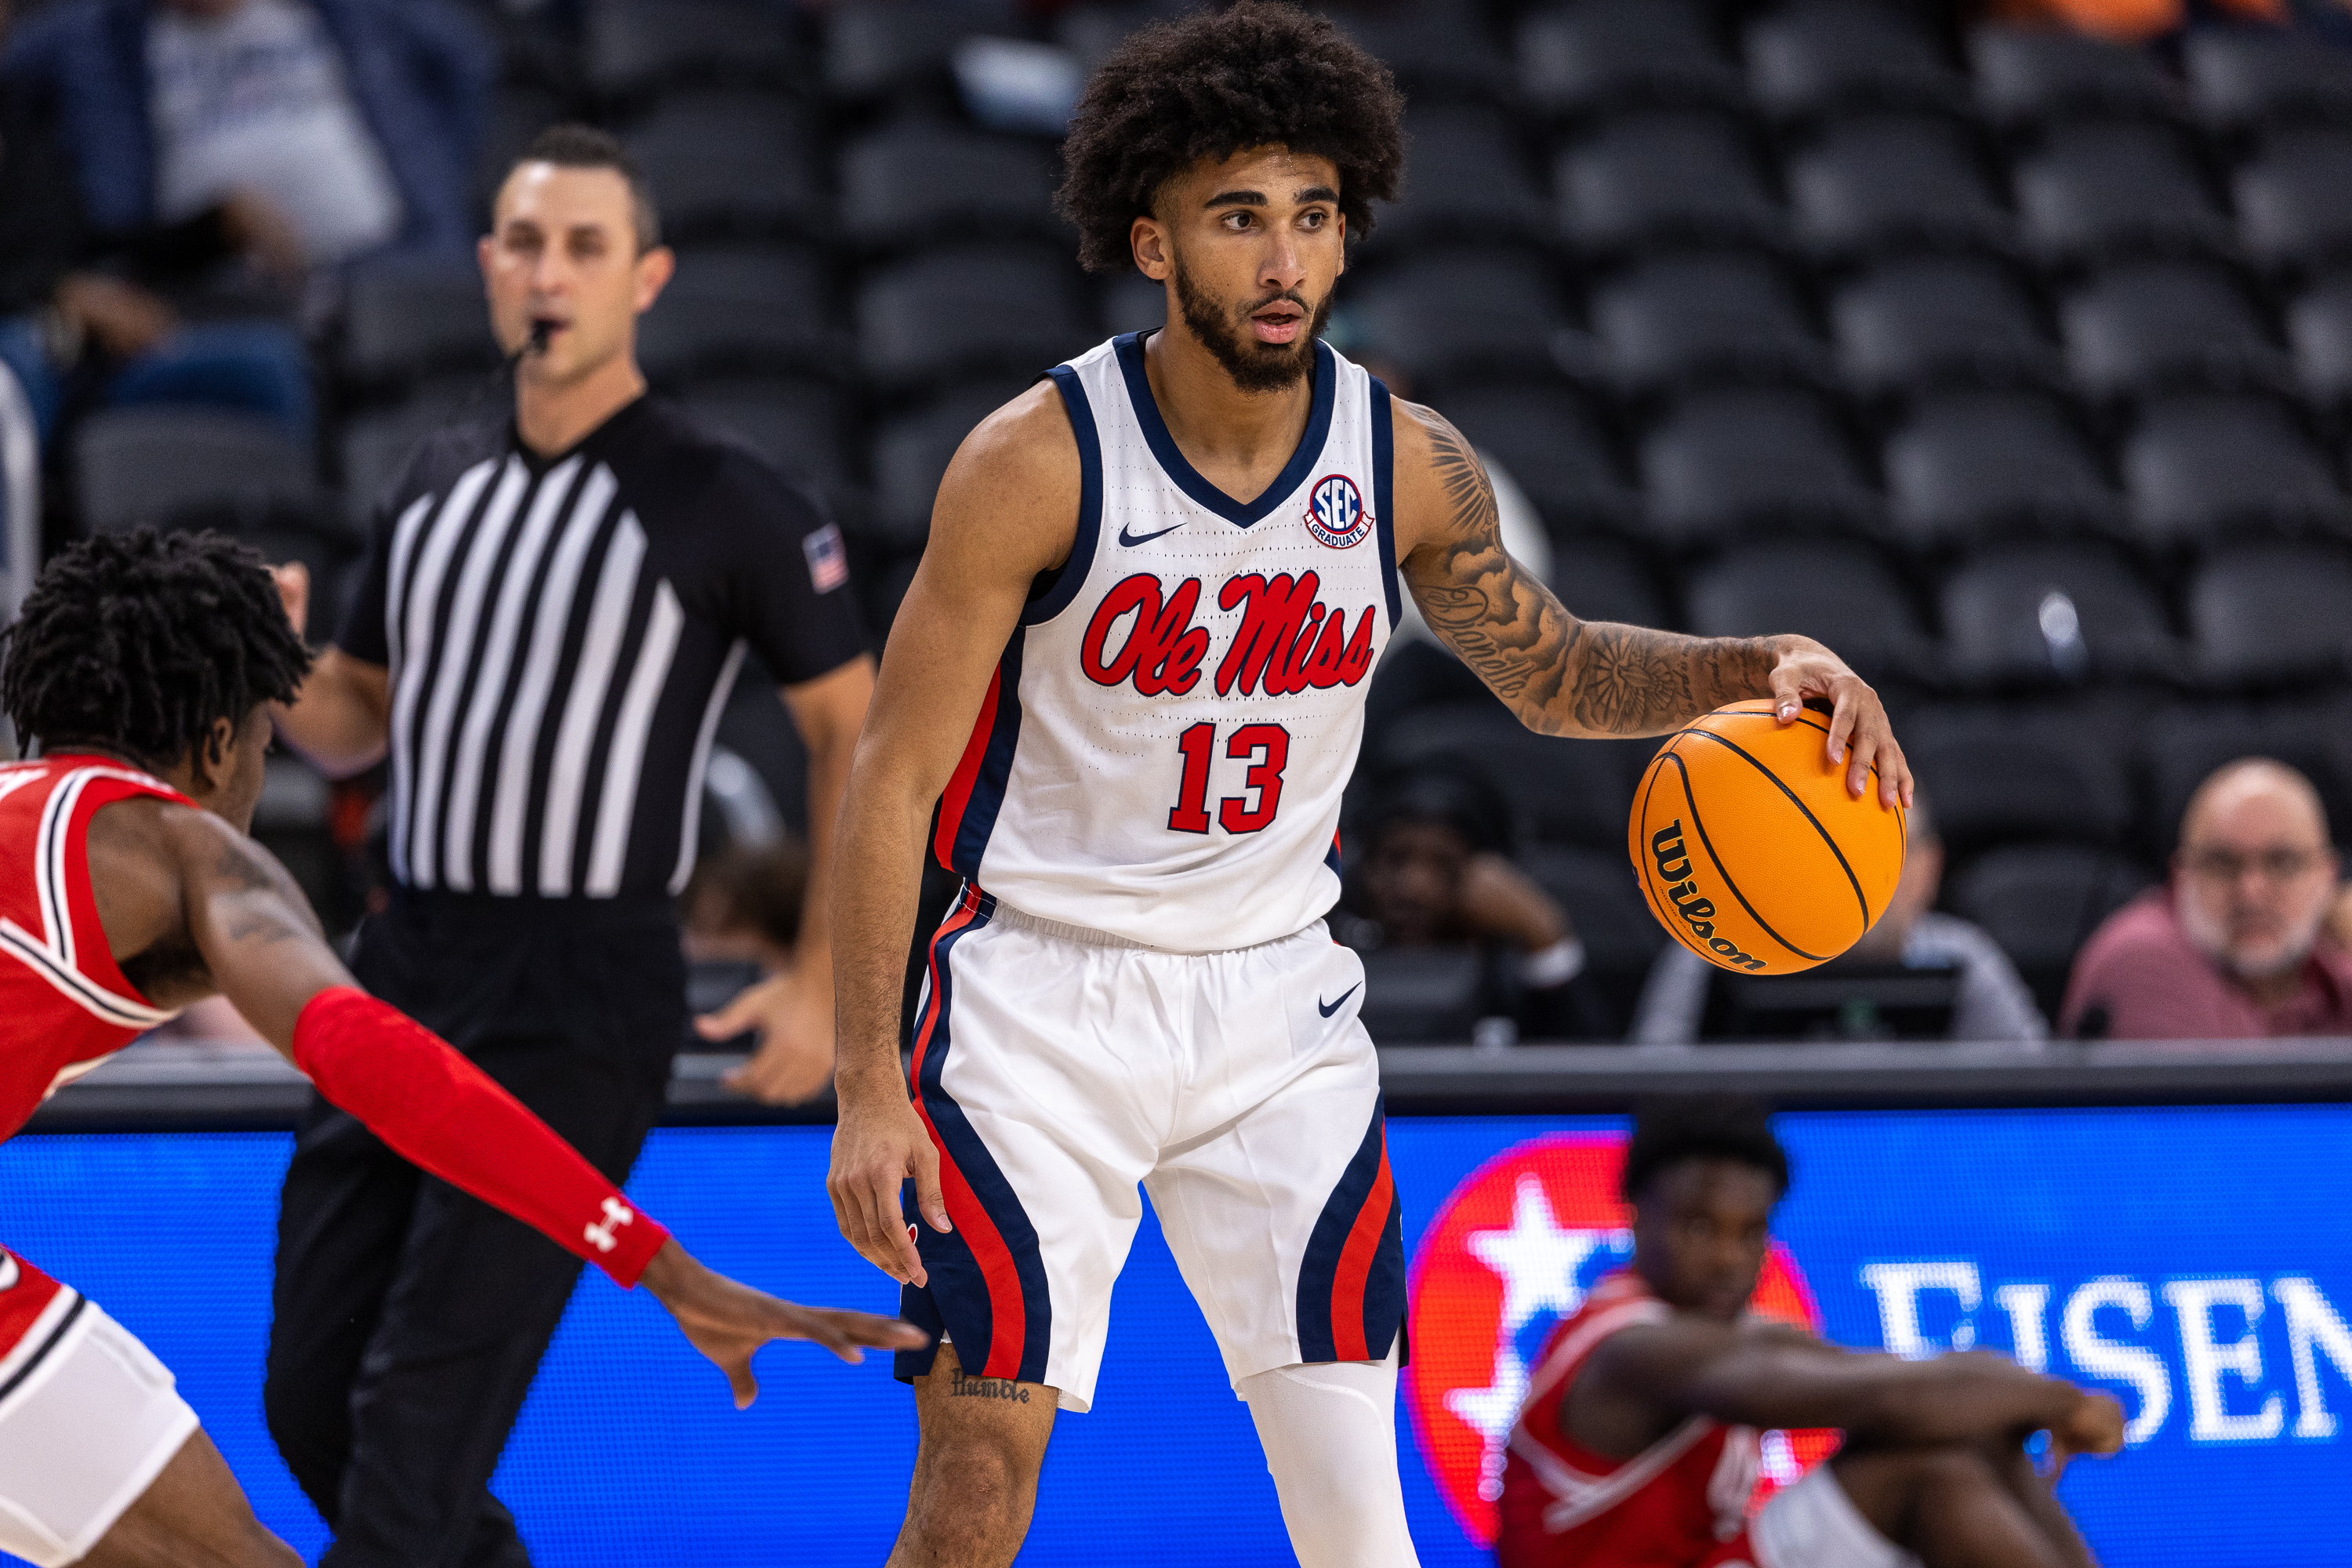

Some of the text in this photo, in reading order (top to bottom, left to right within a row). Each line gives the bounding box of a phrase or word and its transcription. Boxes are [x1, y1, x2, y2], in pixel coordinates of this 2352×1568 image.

[1312, 524, 1365, 546] GRADUATE
[1315, 478, 1358, 529] SEC
[1080, 570, 1376, 697] Ole Miss
[1167, 721, 1290, 835] 13
[1651, 818, 1767, 972] Wilson
[950, 1367, 1030, 1404] Humble
